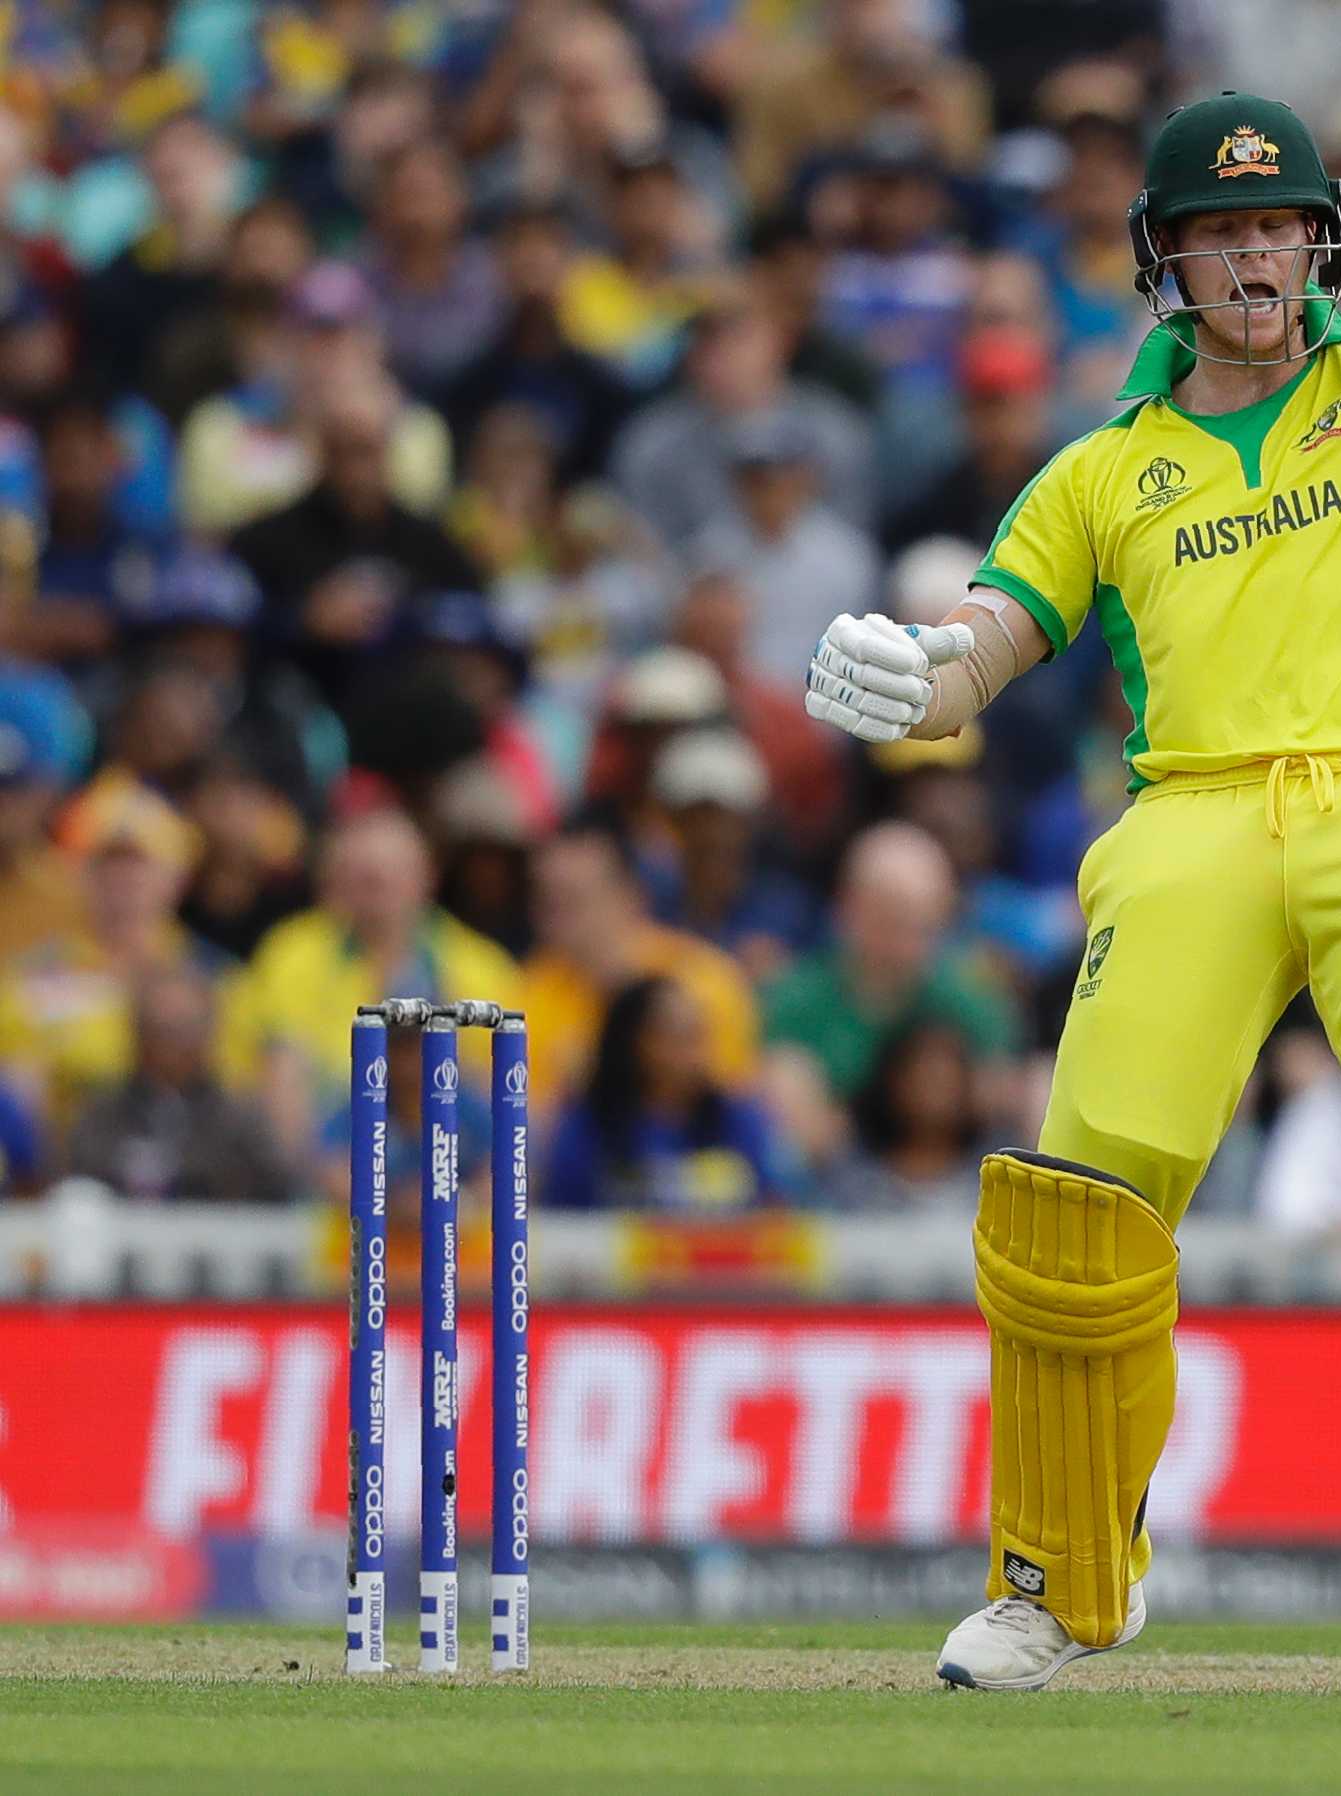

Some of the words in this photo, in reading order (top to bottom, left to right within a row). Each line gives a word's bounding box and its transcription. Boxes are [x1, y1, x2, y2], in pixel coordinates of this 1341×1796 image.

[372, 1121, 386, 1216] NISSAN
[432, 1123, 451, 1202] MRF
[514, 1126, 528, 1220] NISSAN
[441, 1222, 455, 1331] Booking.com
[370, 1350, 385, 1444] NISSAN
[434, 1351, 452, 1430] MRF
[515, 1354, 529, 1448] NISSAN
